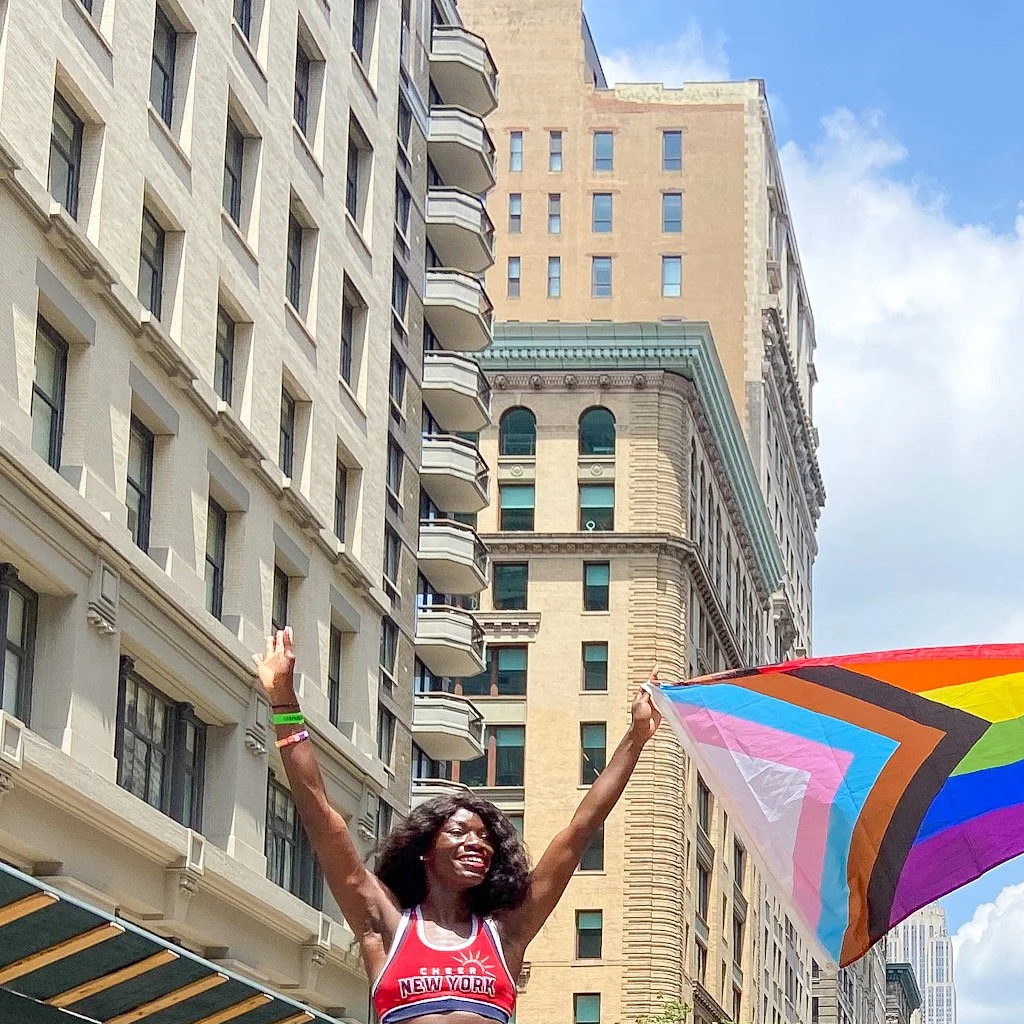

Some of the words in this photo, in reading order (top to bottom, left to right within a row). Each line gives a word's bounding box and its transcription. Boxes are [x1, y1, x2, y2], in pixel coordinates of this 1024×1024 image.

[419, 966, 478, 977] CHEER
[398, 975, 444, 999] NEW
[445, 974, 497, 997] YORK
